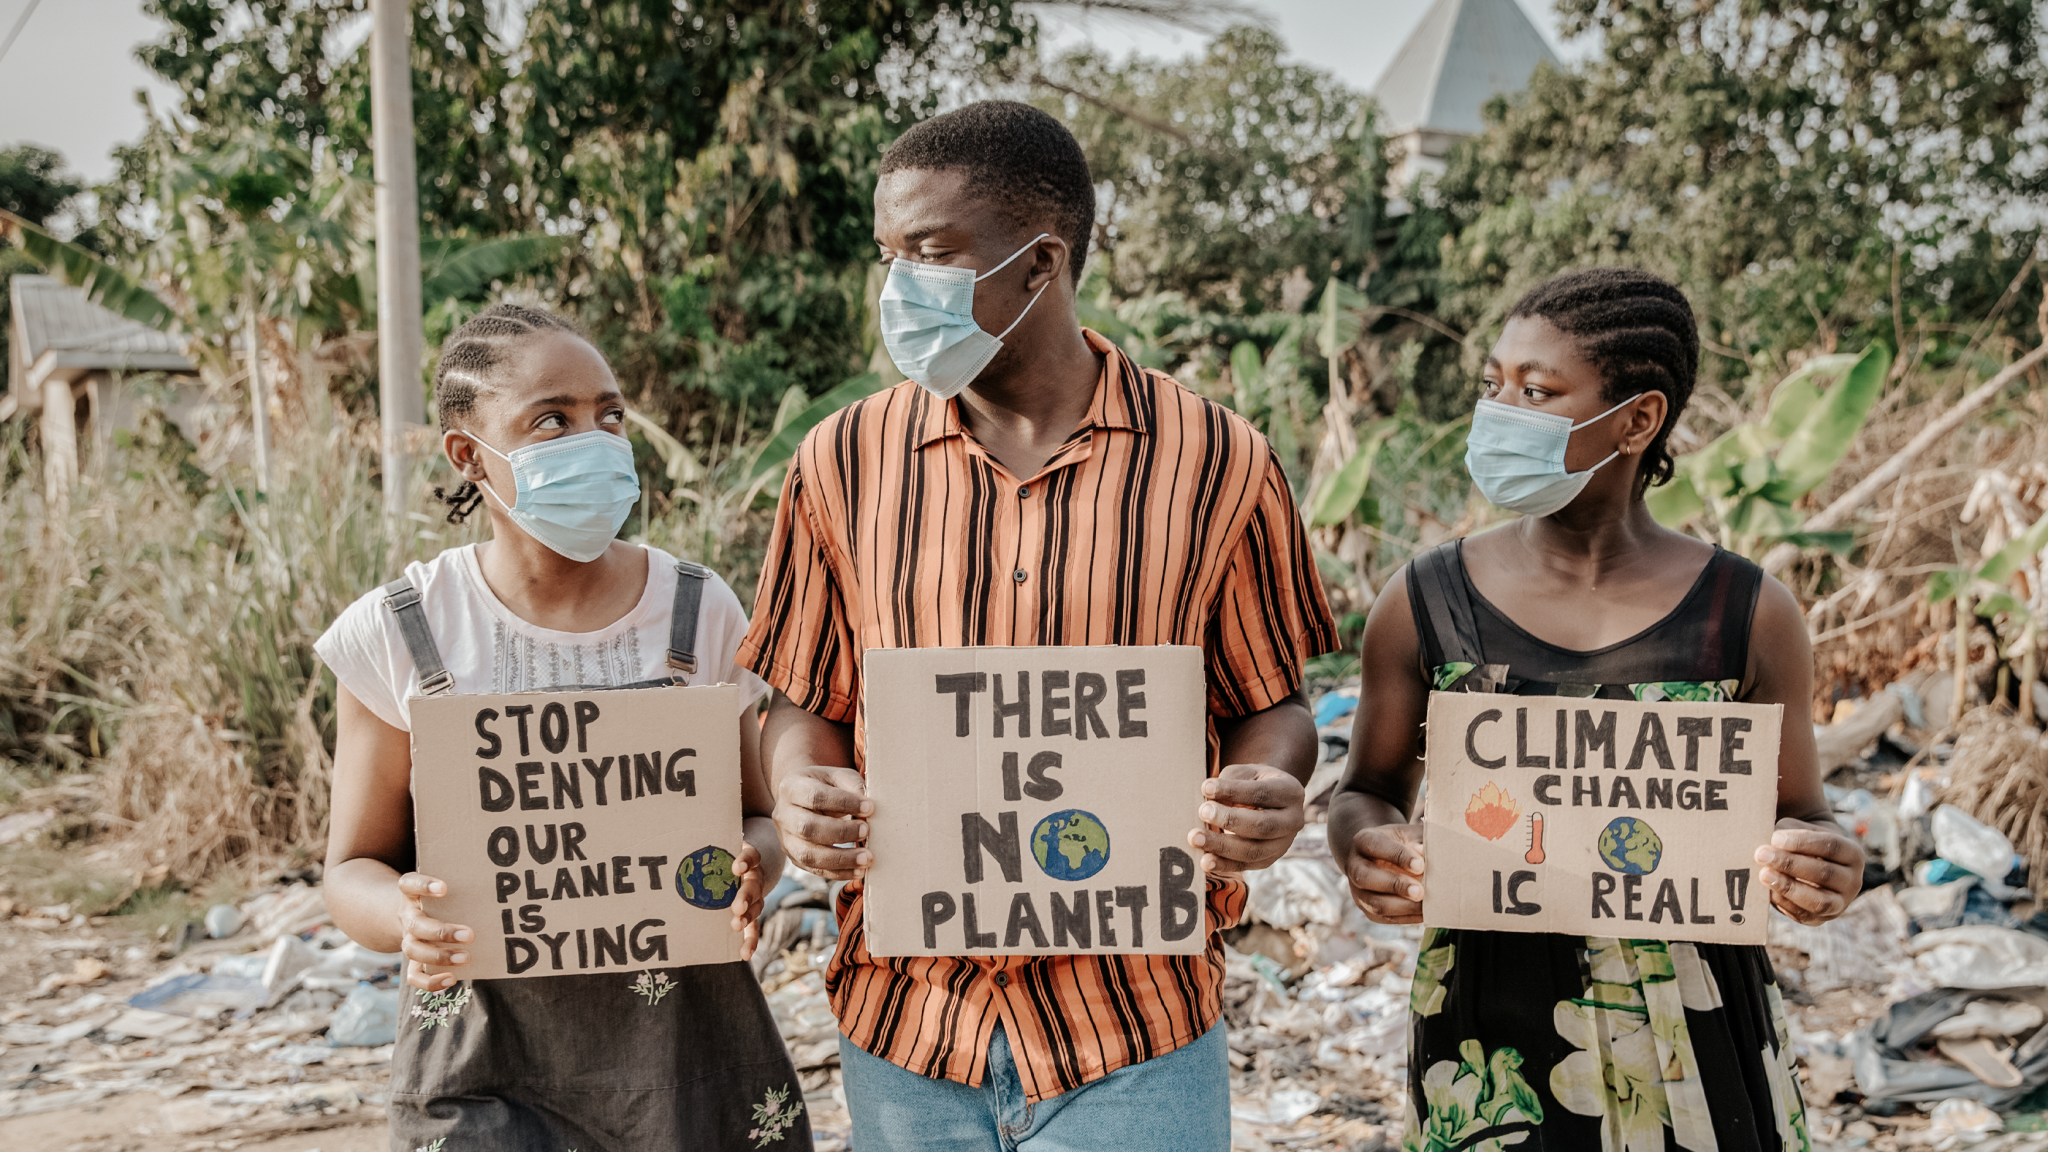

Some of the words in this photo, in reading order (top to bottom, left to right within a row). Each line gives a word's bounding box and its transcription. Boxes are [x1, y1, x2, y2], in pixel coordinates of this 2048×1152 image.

[475, 701, 600, 759] STOP
[935, 669, 1148, 740] THERE
[1465, 707, 1753, 775] CLIMATE
[478, 748, 697, 812] DENYING
[1002, 750, 1064, 801] IS
[1532, 774, 1729, 811] CHANGE
[487, 821, 587, 867] OUR
[495, 855, 668, 903] PLANET
[922, 885, 1149, 949] PLANET
[1159, 846, 1199, 942] B
[1492, 869, 1542, 916] IS
[1591, 868, 1751, 926] REAL!
[501, 904, 547, 935] IS
[505, 918, 669, 974] DYING
